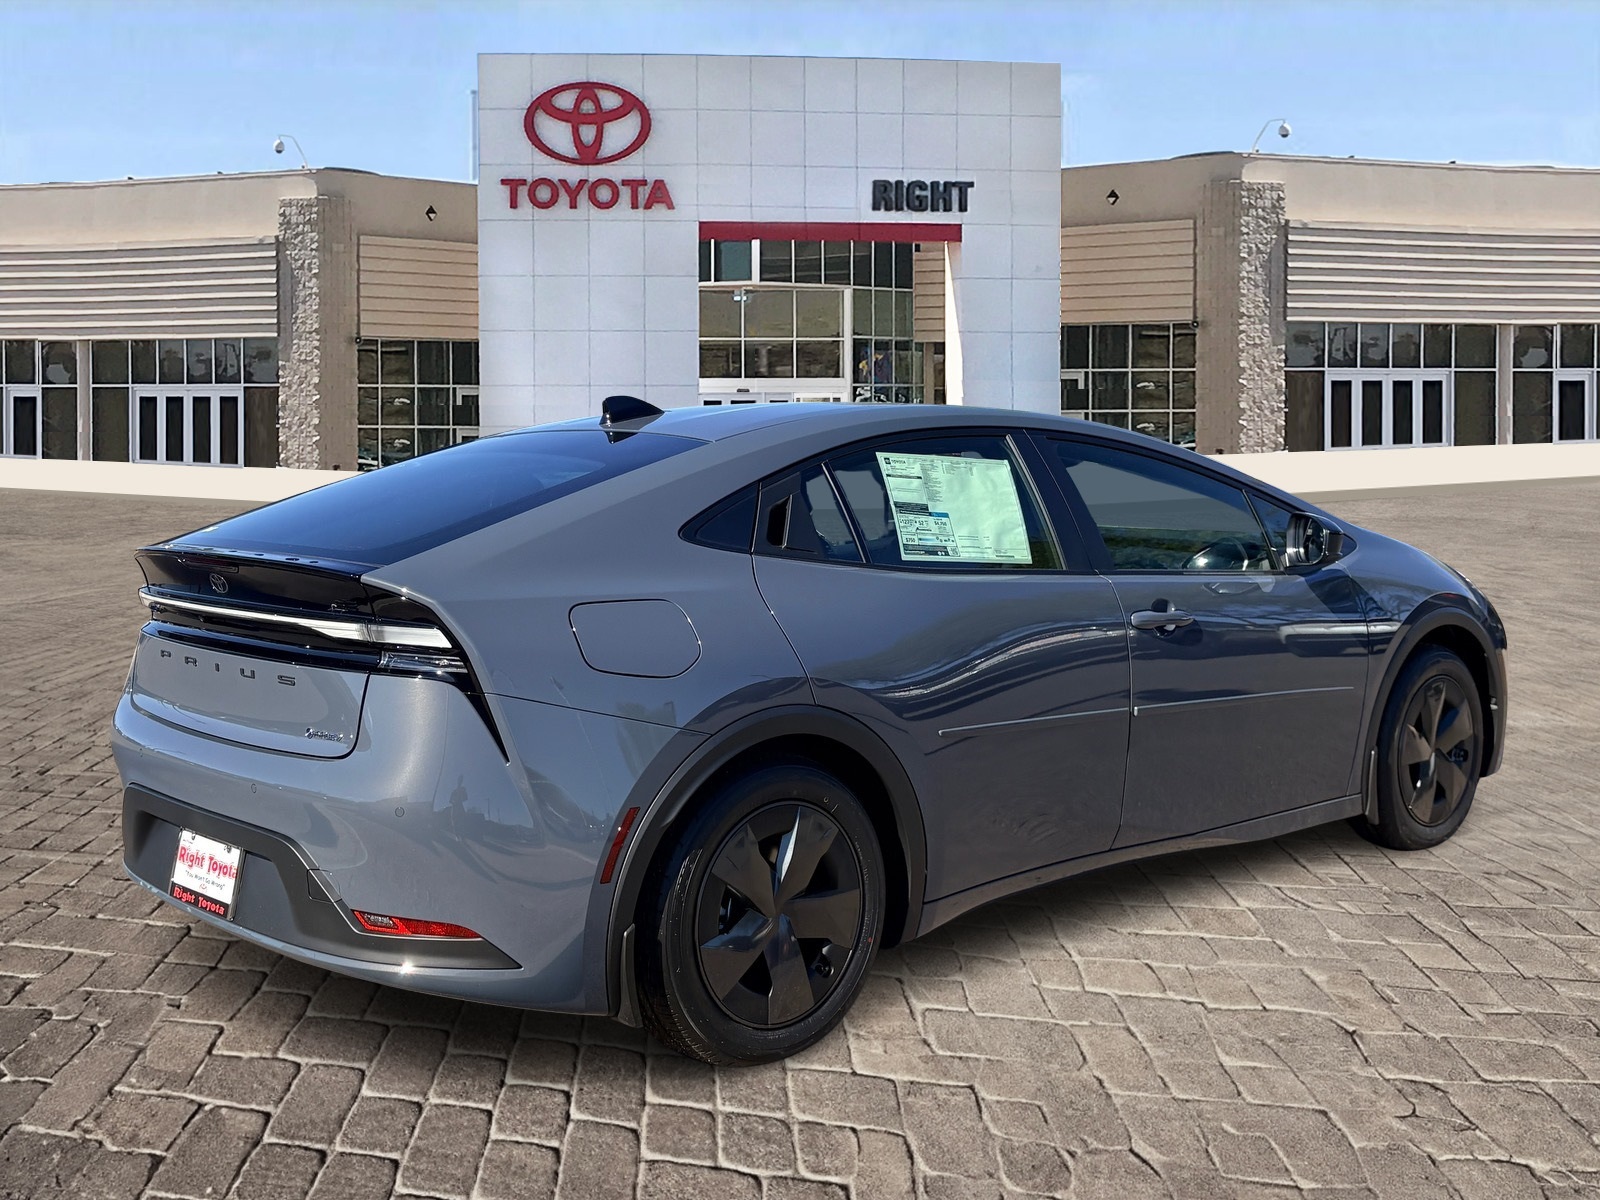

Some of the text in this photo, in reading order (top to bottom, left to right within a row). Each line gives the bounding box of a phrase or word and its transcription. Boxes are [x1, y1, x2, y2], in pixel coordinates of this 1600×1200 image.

[500, 177, 675, 210] TOYOTA
[872, 179, 975, 212] RIGHT
[160, 649, 296, 687] PRIUS
[178, 846, 238, 879] Right Toyota
[173, 886, 225, 915] Right Toyota
